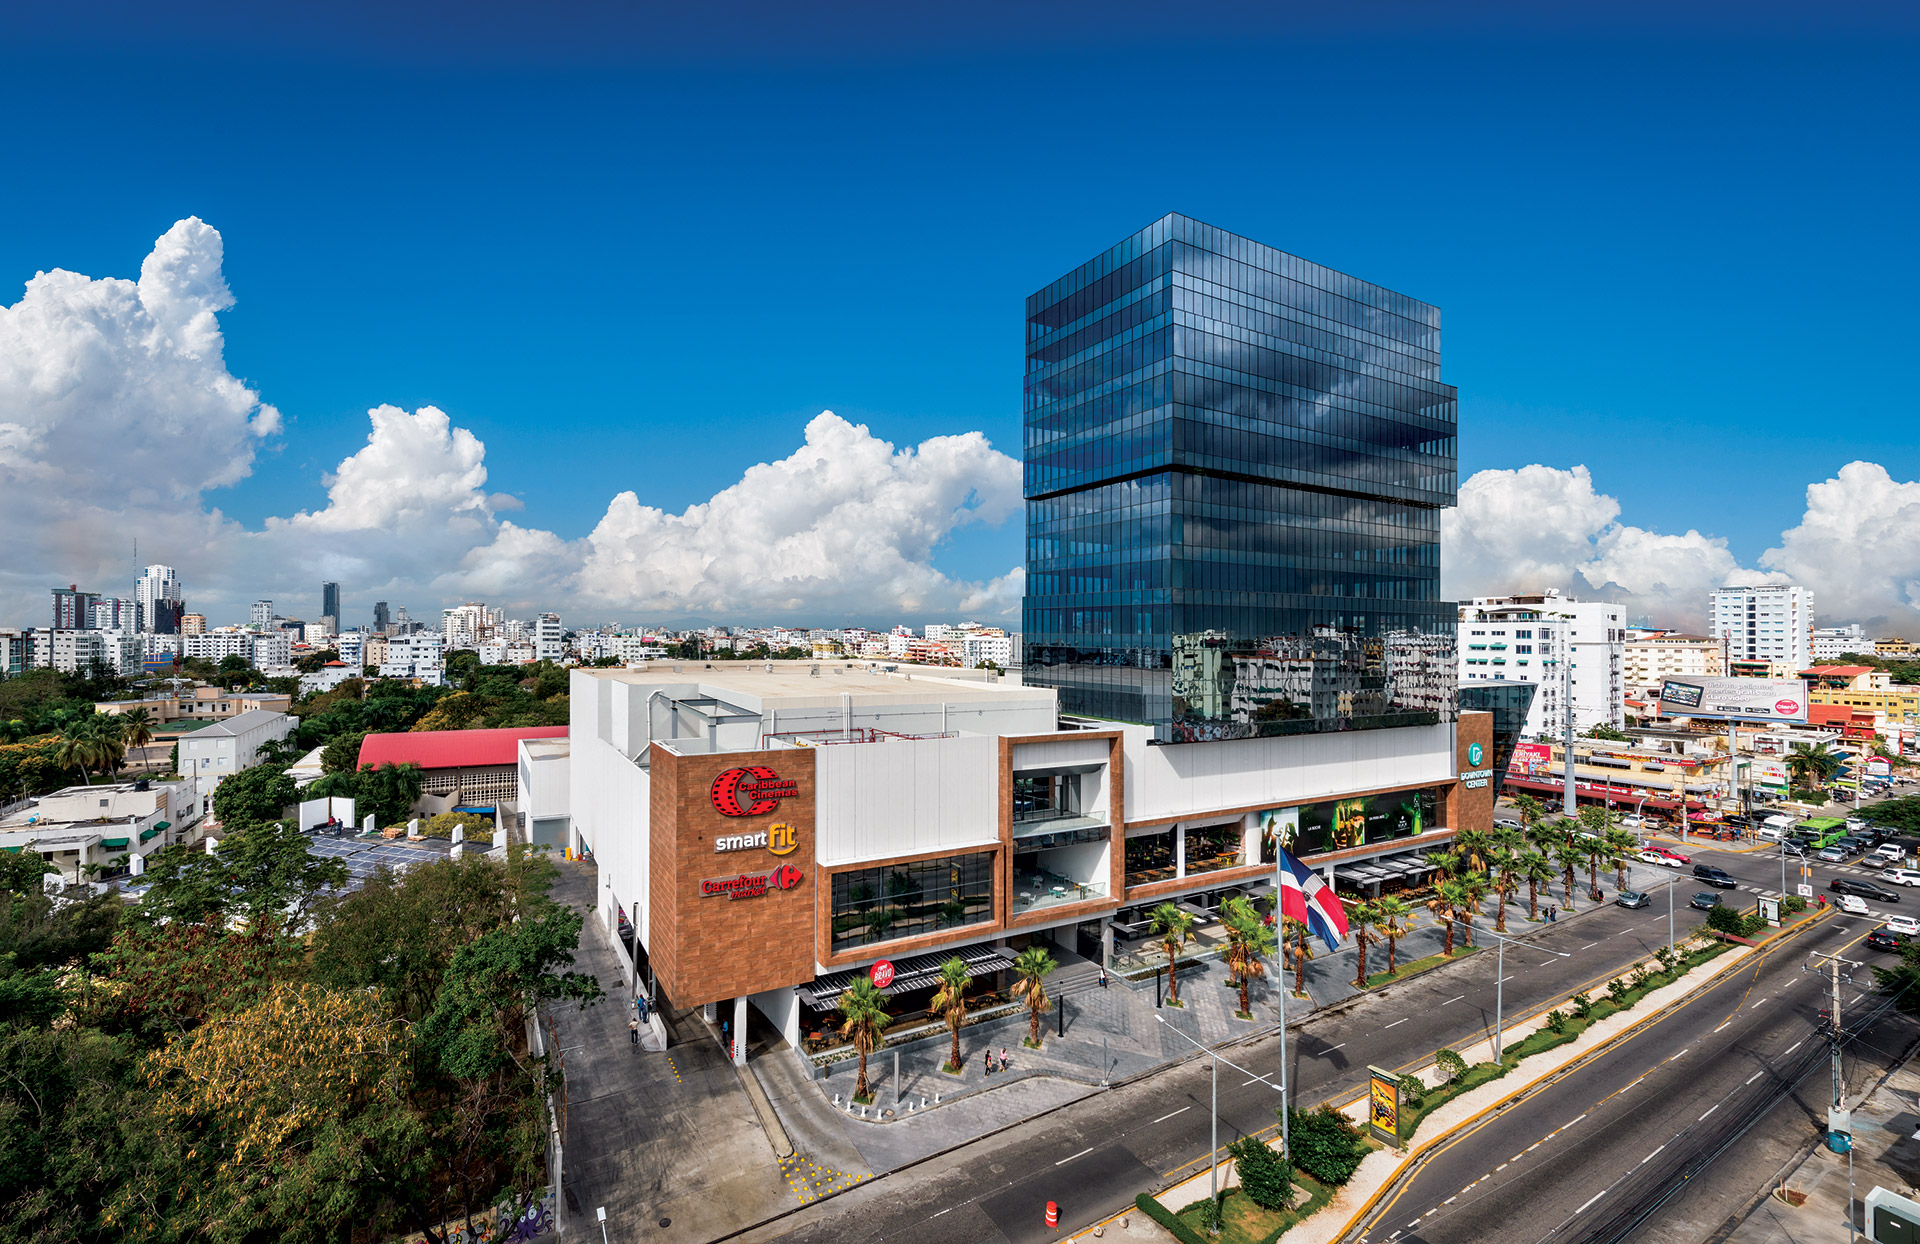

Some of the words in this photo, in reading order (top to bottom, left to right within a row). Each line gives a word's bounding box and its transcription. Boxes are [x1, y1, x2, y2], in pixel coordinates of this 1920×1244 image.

[1706, 693, 1728, 701] Claro
[1729, 694, 1750, 702] video
[1460, 769, 1493, 781] DOWNTOWN
[738, 779, 795, 791] Caribbean
[1466, 779, 1488, 789] CENTER
[749, 788, 798, 800] Cinemas
[716, 831, 767, 851] smart
[769, 823, 796, 848] fit
[702, 875, 767, 894] Carrefour
[730, 885, 767, 899] market
